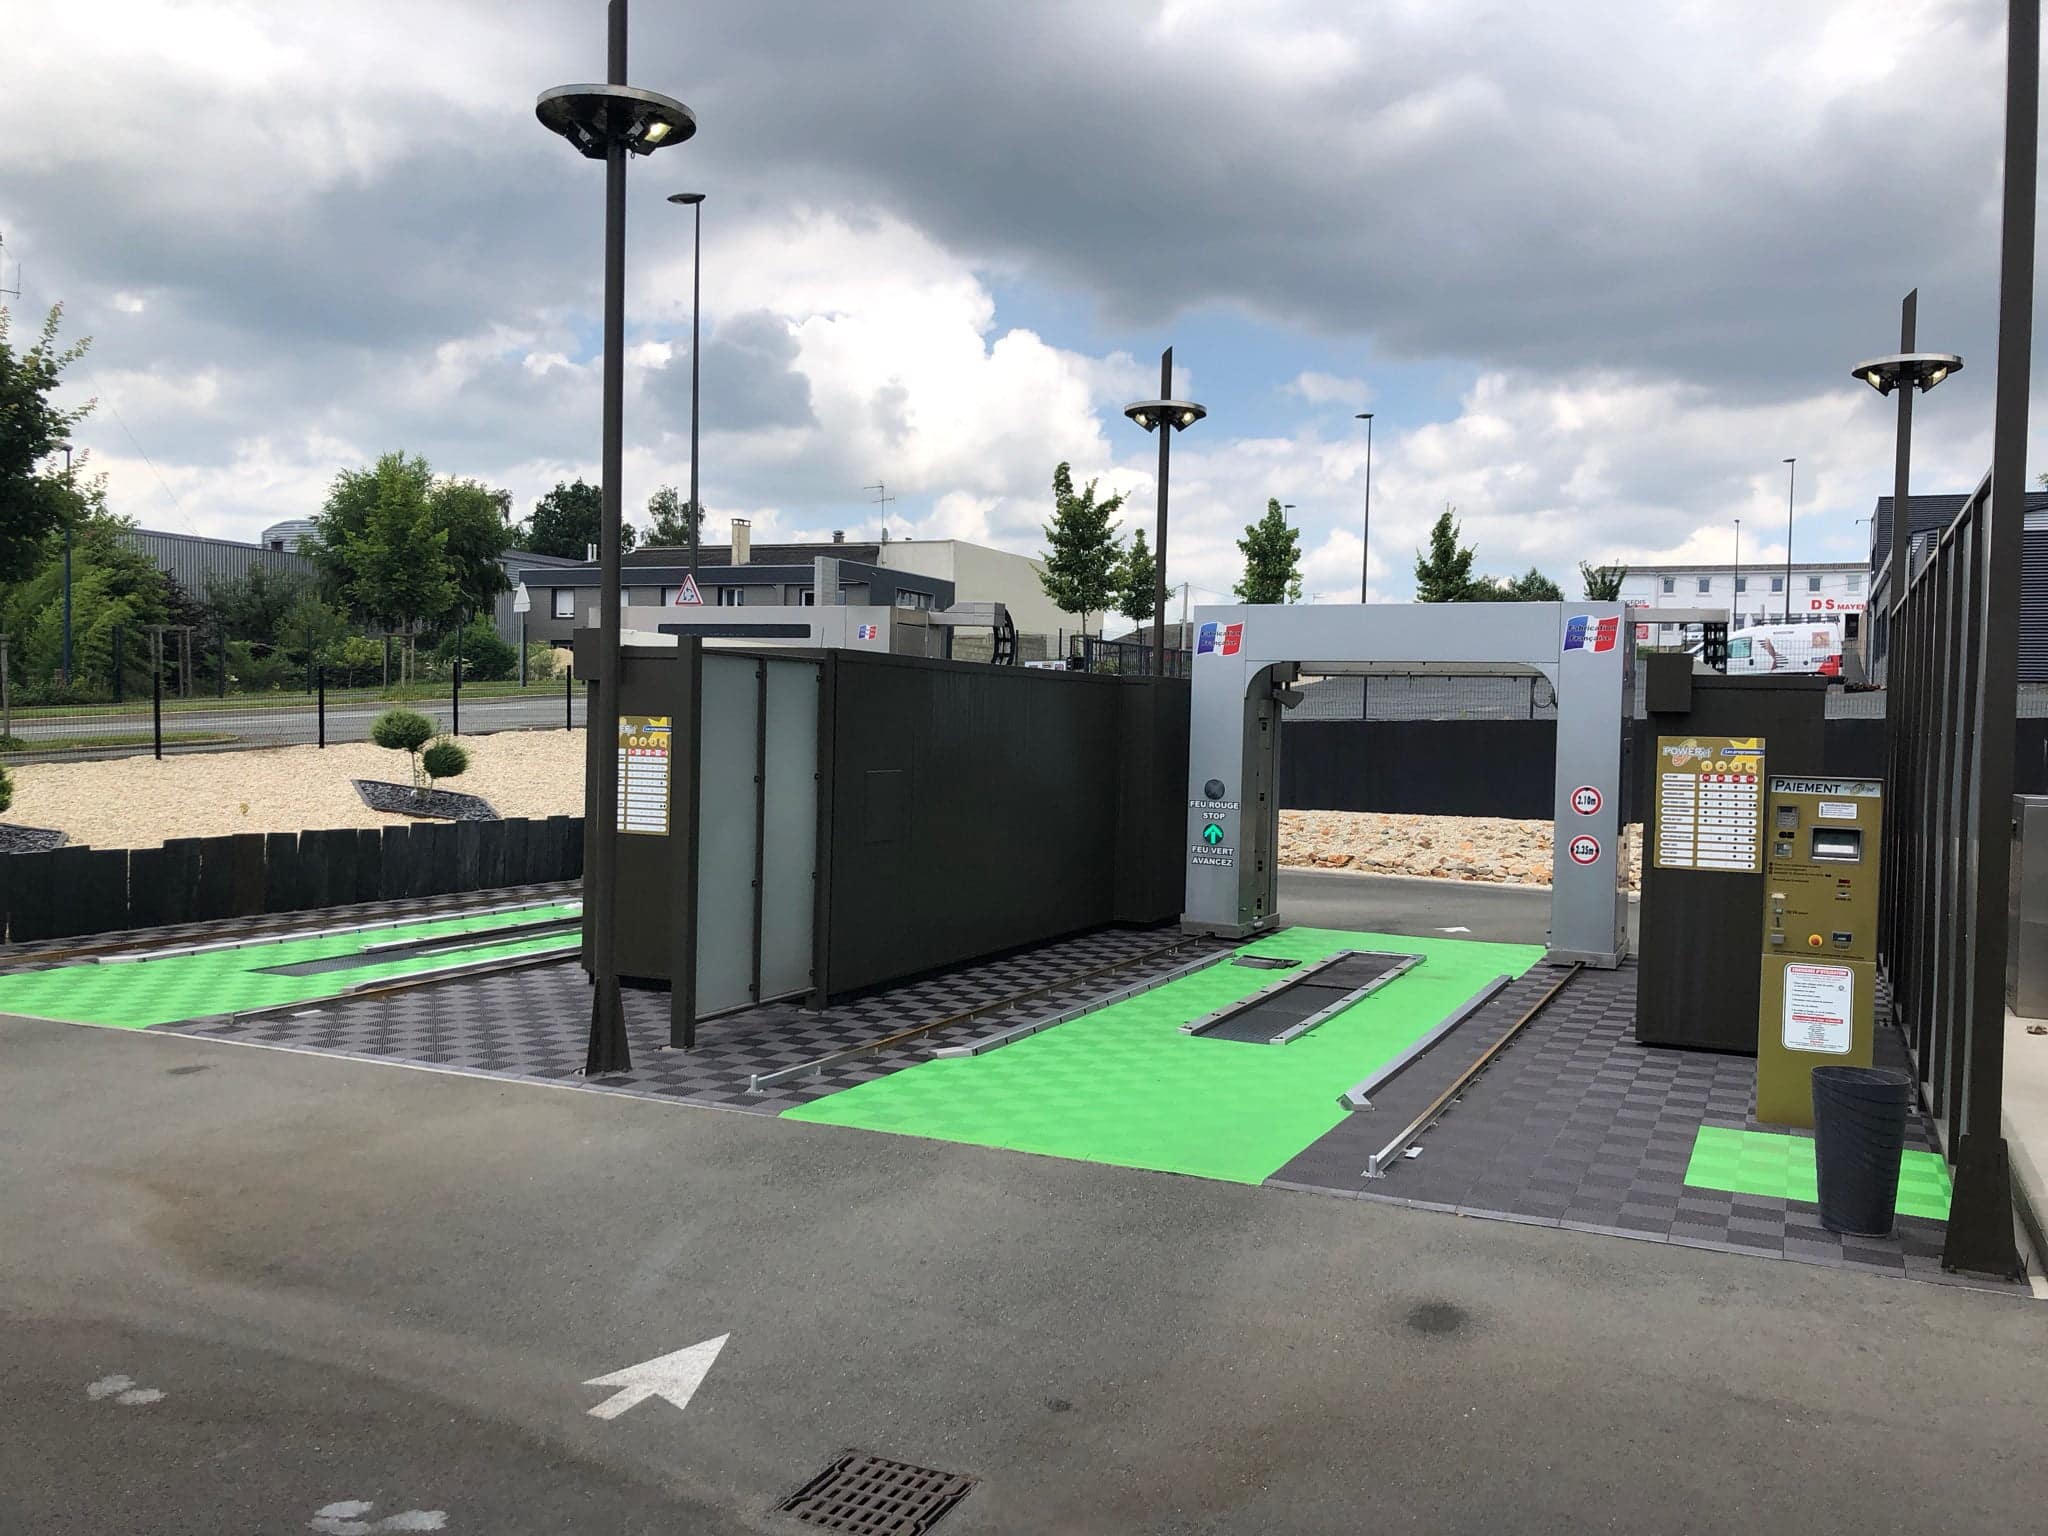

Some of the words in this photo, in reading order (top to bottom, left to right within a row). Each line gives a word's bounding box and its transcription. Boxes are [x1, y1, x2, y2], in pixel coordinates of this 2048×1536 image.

[1775, 780, 1841, 793] PAIEMENT
[1190, 800, 1207, 808] FEU
[1208, 801, 1240, 809] ROUGE
[1202, 812, 1225, 820] STOP
[1191, 845, 1209, 853] FEU
[1210, 846, 1234, 855] VERT
[1192, 857, 1233, 866] AVANCEZ
